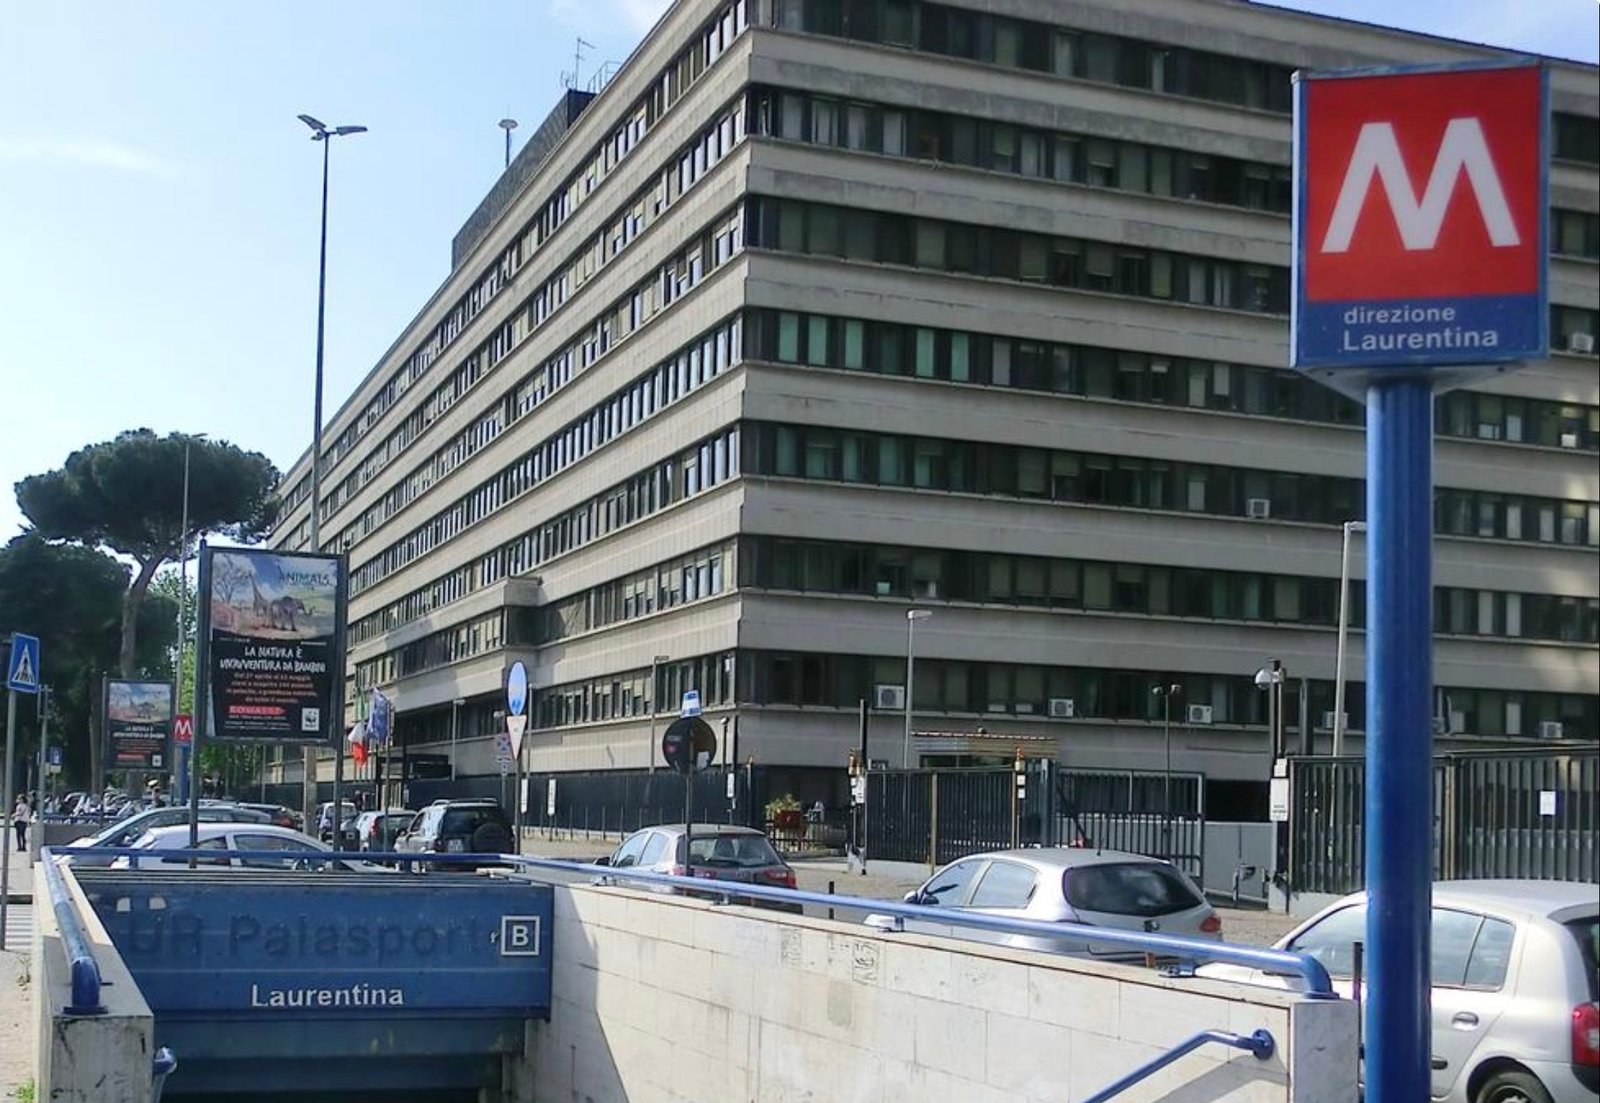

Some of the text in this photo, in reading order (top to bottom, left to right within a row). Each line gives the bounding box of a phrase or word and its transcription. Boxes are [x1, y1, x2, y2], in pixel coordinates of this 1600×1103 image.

[1320, 117, 1521, 253] M
[1343, 305, 1456, 325] direzione
[1343, 327, 1499, 352] Laurentina
[244, 646, 256, 657] LA
[258, 646, 294, 658] NATURA
[511, 925, 529, 946] B
[250, 983, 404, 1007] Laurentina
